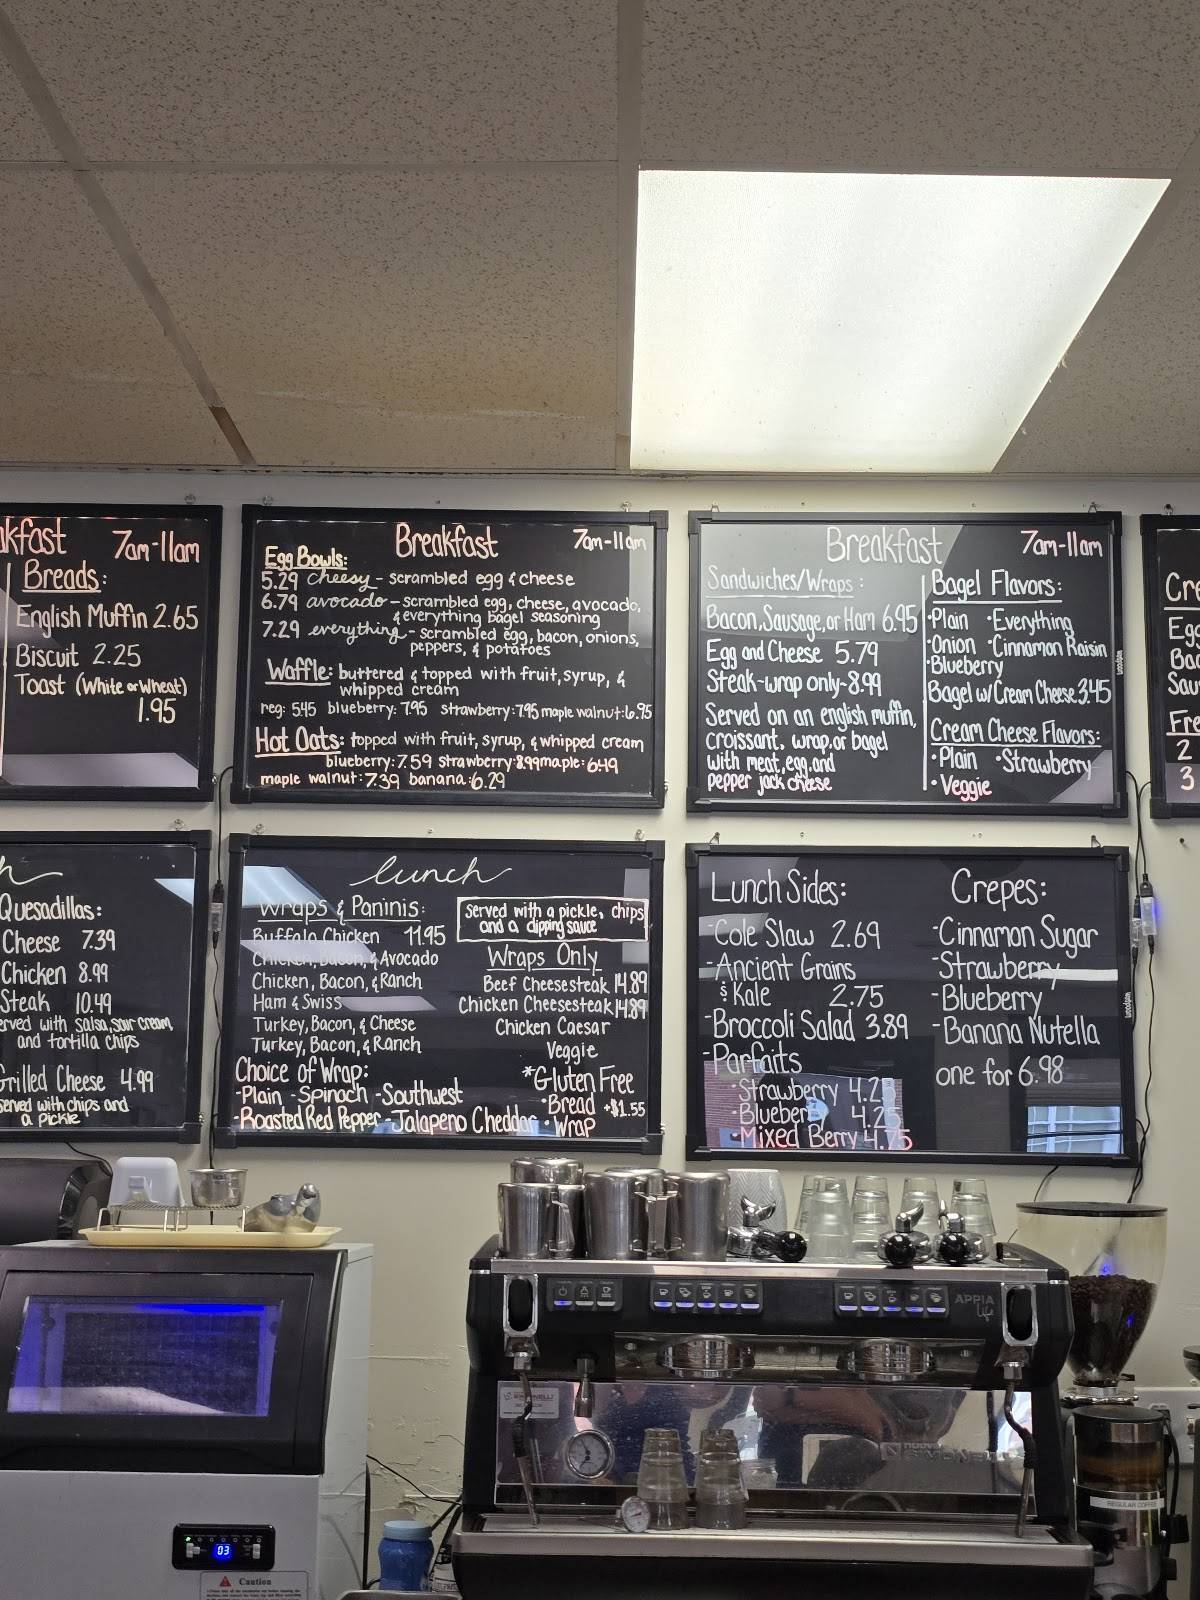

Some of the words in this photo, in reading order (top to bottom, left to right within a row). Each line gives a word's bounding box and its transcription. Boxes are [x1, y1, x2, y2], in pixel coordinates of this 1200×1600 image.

[395, 522, 499, 559] Breakfast
[826, 526, 943, 564] Breakfast
[265, 546, 293, 571] Egg
[297, 545, 348, 567] Bowls:
[23, 559, 107, 590] Breads:
[261, 571, 298, 590] 5.29
[389, 569, 468, 585] scrambled
[476, 572, 503, 591] egg
[519, 571, 575, 586] cheese
[932, 568, 981, 600] Bagel
[992, 569, 1062, 597] Flavors:
[261, 594, 298, 611] 6.79
[306, 592, 388, 609] avocado
[402, 595, 478, 608] scrambled
[517, 596, 569, 612] cheese,
[16, 604, 81, 638] English
[88, 604, 148, 629] Muffin
[152, 604, 199, 630] 2.65
[403, 610, 481, 629] everything
[488, 611, 524, 630] bagel
[531, 611, 600, 630] seasoning
[844, 607, 875, 631] Ham
[883, 604, 918, 633] 6.95
[262, 620, 299, 638] 7.29
[420, 627, 496, 640] scrambled
[537, 629, 582, 647] bacon,
[586, 631, 639, 647] onions,
[16, 643, 79, 668] Biscuit
[92, 643, 142, 666] 2.25
[486, 645, 550, 659] potatoes
[707, 639, 737, 670] Egg
[742, 640, 764, 661] and
[768, 639, 824, 663] Cheese
[836, 640, 878, 666] 5.79
[1067, 638, 1107, 657] Raisin
[268, 657, 333, 681] Waffle:
[339, 663, 403, 681] buttered
[422, 666, 472, 684] topped
[481, 667, 515, 681] with
[14, 673, 66, 696] Toast
[76, 672, 124, 696] (White
[340, 682, 403, 700] whipped
[412, 683, 459, 696] cream
[928, 680, 972, 710] Bagel
[1035, 679, 1077, 703] Cheese
[1078, 678, 1112, 704] 3.45
[138, 697, 176, 724] 1.95
[328, 702, 396, 720] blueberry:
[400, 701, 428, 716] 7.95
[542, 706, 574, 722] maple
[705, 702, 760, 727] Served
[768, 709, 788, 725] on
[794, 709, 814, 726] an
[821, 703, 868, 732] english
[872, 699, 917, 728] muffin,
[255, 726, 290, 752] Hot
[295, 726, 345, 750] Oats:
[351, 731, 396, 750] topped
[404, 732, 435, 745] with
[482, 734, 524, 751] syrup,
[540, 734, 595, 752] whipped
[602, 737, 643, 752] cream
[852, 730, 888, 758] bagel
[931, 718, 984, 742] Cream
[988, 718, 1038, 743] Cheese
[1043, 720, 1100, 744] Flavors:
[326, 755, 394, 772] blueberry:
[397, 754, 432, 769] 7.59
[707, 750, 740, 770] with
[260, 774, 300, 788] maple
[309, 772, 362, 784] walnut:
[365, 773, 400, 790] 7.39
[471, 772, 505, 790] 6.29
[708, 773, 752, 792] pepper
[757, 774, 784, 796] jack
[788, 773, 832, 792] cheese
[350, 855, 512, 886] lunch
[712, 869, 782, 904] Lunch
[787, 869, 847, 906] Sides:
[952, 868, 1046, 912] Crepes:
[0, 893, 102, 923] Quesadillas:
[514, 903, 542, 918] with
[547, 908, 555, 918] a
[3, 929, 61, 954] Cheese
[81, 929, 115, 951] 7.39
[480, 920, 504, 934] and
[508, 923, 519, 933] a
[527, 920, 565, 939] dipping
[567, 921, 597, 934] sauce
[765, 918, 814, 948] Slaw
[831, 920, 881, 949] 2.69
[1041, 914, 1098, 959] Sugar
[380, 950, 439, 966] Avocado
[488, 944, 545, 972] Wraps
[557, 941, 598, 976] Only
[801, 952, 857, 980] Grains
[1, 961, 66, 986] Chicken
[78, 963, 108, 984] 8.99
[381, 972, 423, 990] Ranch
[483, 975, 517, 993] Beef
[523, 975, 610, 994] Cheesesteak
[615, 971, 648, 994] 14.89
[1, 989, 49, 1013] Steak
[76, 992, 112, 1015] 10.49
[253, 994, 287, 1012] Ham
[302, 994, 343, 1010] Swiss
[459, 997, 518, 1014] Chicken
[524, 996, 614, 1015] Cheesesteak
[734, 982, 771, 1006] Kale
[829, 984, 884, 1008] 2.75
[40, 1015, 67, 1033] with
[370, 1015, 416, 1031] Cheese
[496, 1018, 550, 1036] Chicken
[558, 1016, 610, 1035] Caesar
[801, 1009, 855, 1041] Salad
[866, 1014, 909, 1040] 3.89
[1028, 1015, 1100, 1045] Nutella
[18, 1034, 41, 1049] and
[48, 1033, 100, 1050] tortilla
[105, 1034, 139, 1053] chips
[374, 1035, 422, 1053] Ranch
[547, 1041, 598, 1065] Veggie
[56, 1065, 105, 1092] Cheese
[121, 1067, 154, 1093] 4.99
[235, 1056, 289, 1083] Choice
[320, 1057, 369, 1087] Wrap:
[600, 1065, 634, 1094] Free
[936, 1066, 975, 1086] one
[983, 1058, 1013, 1086] for
[1019, 1055, 1064, 1087] 6.98
[37, 1096, 66, 1113] with
[67, 1096, 100, 1116] chips
[104, 1097, 128, 1113] and
[306, 1105, 333, 1131] Red
[338, 1105, 381, 1132] Pepper
[473, 1105, 537, 1134] Cheddar
[809, 1124, 857, 1149] Berry
[217, 1546, 230, 1555] 03
